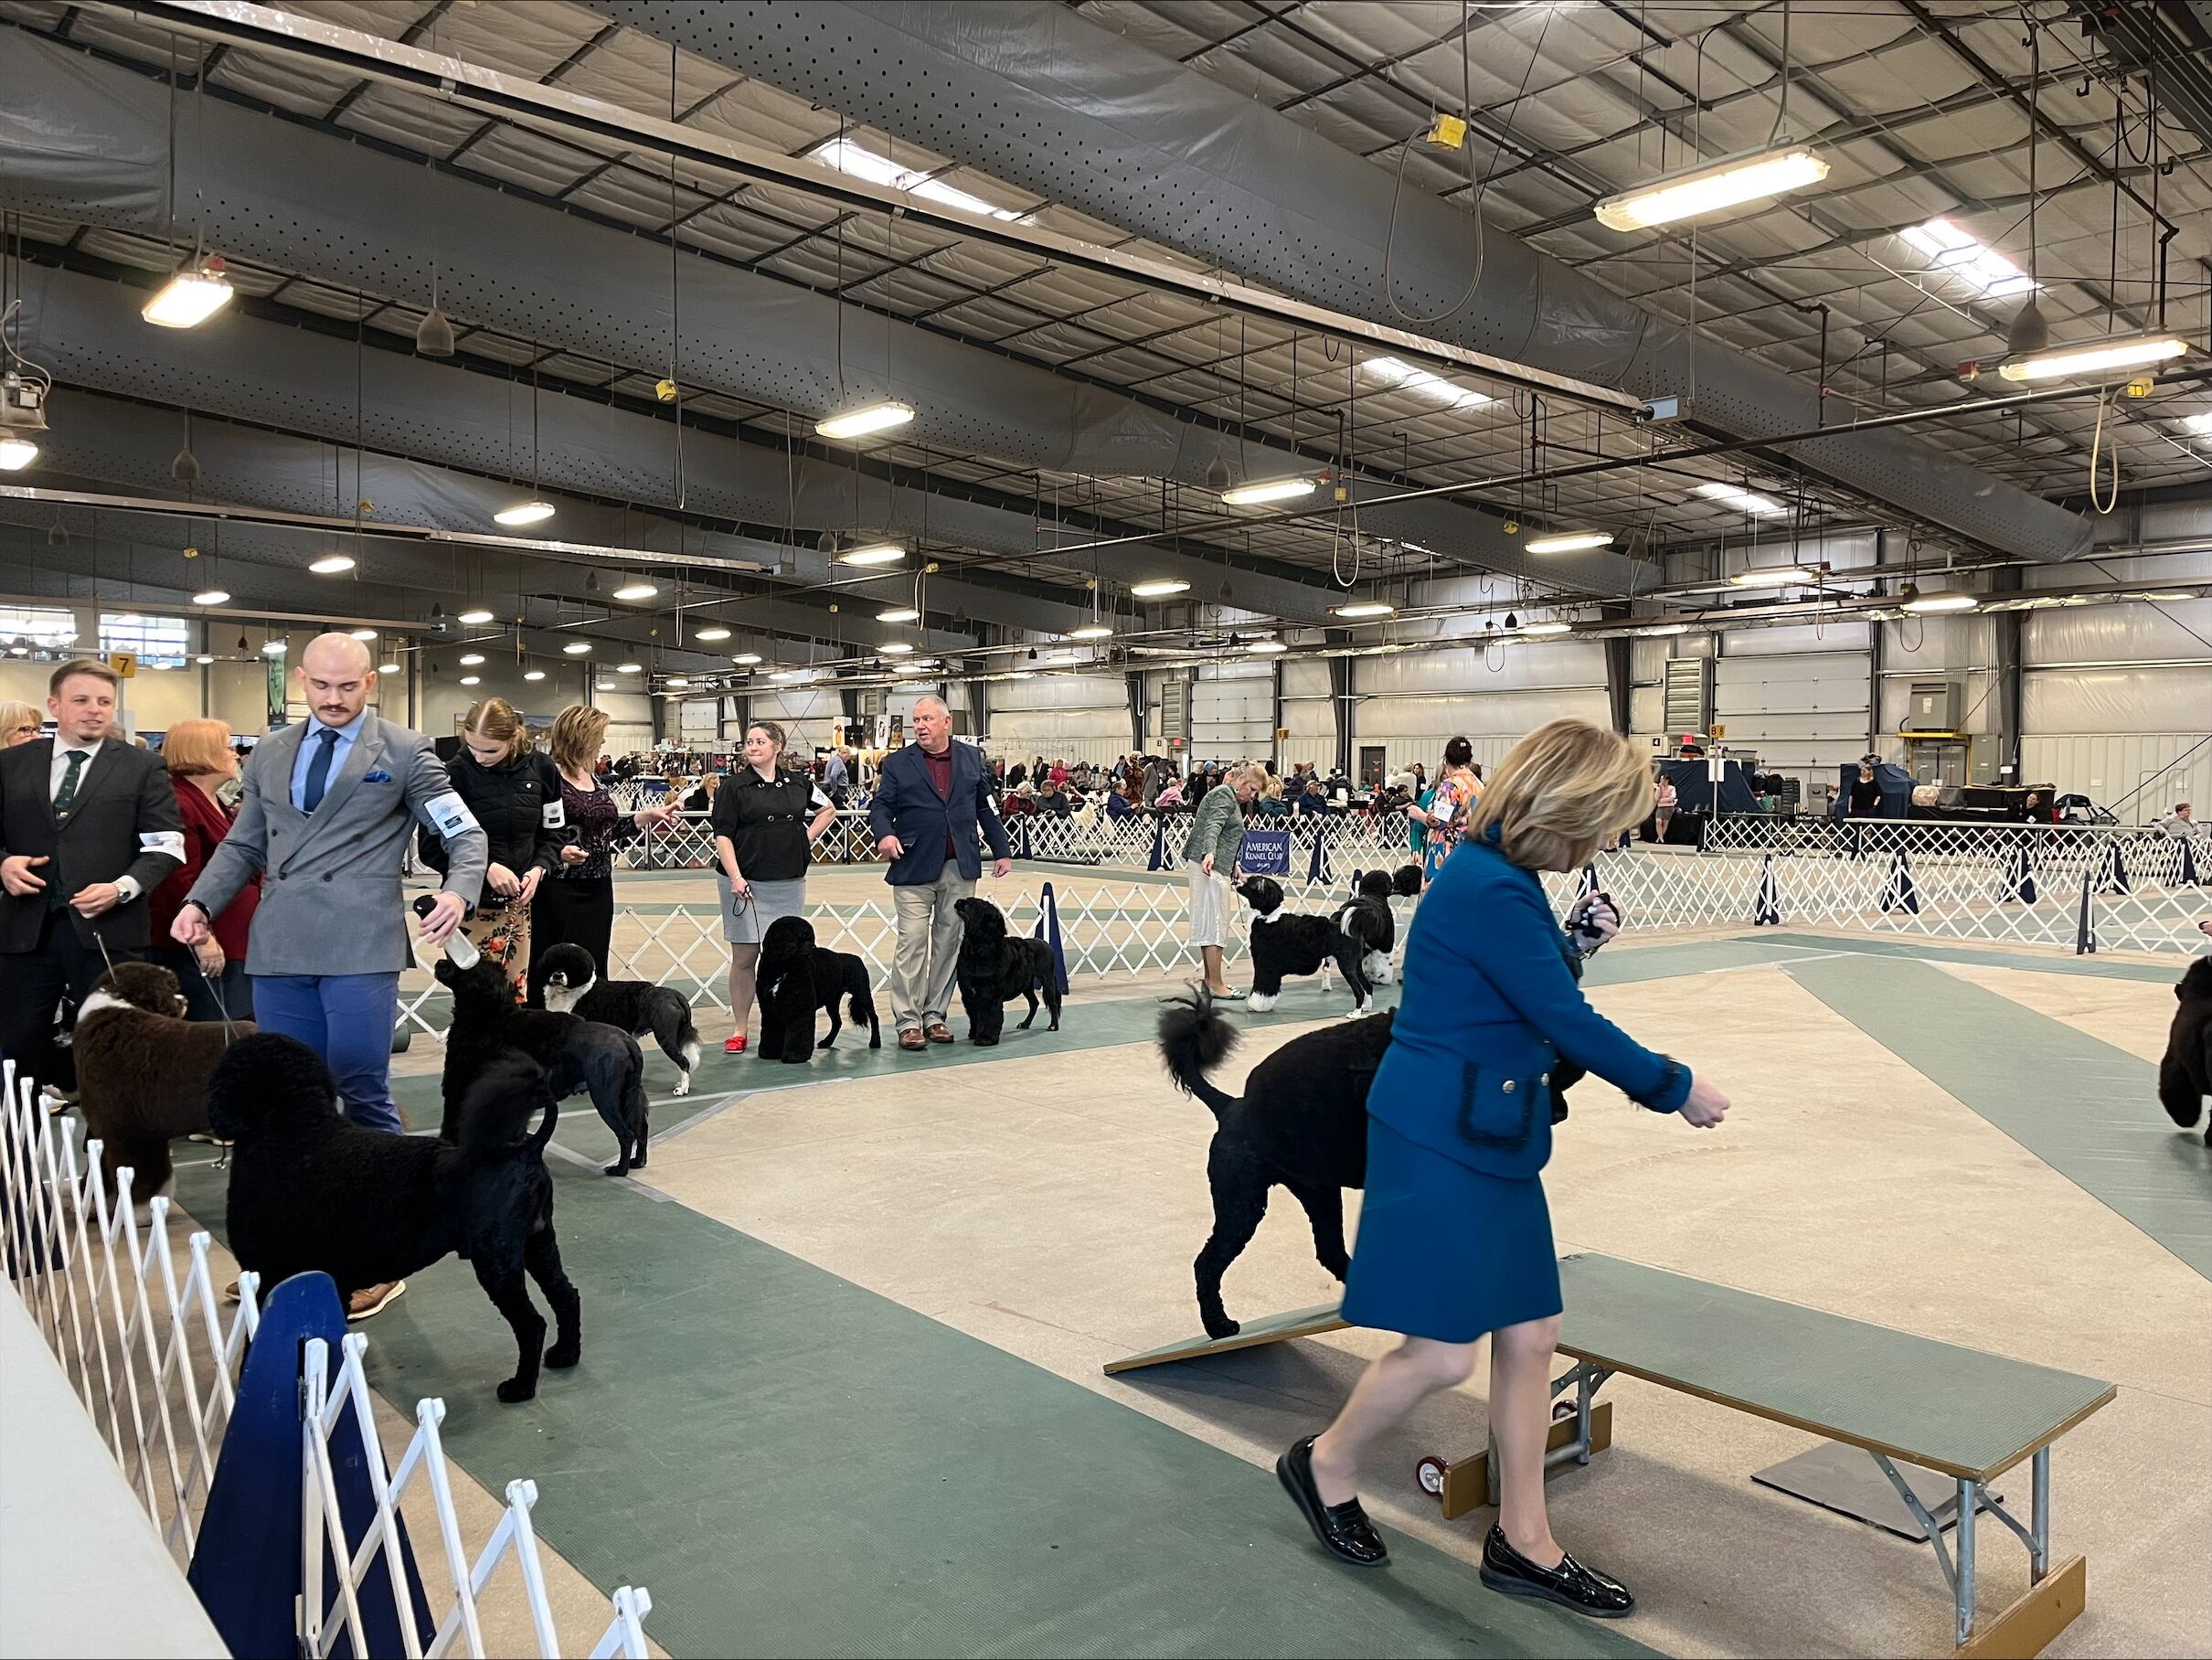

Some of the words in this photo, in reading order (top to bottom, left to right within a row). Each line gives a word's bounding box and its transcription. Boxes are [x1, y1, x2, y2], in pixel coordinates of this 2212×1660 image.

[119, 657, 129, 674] 7
[1711, 726, 1717, 736] 8
[1246, 842, 1282, 851] AMERICAN
[1245, 851, 1266, 859] KENNEL
[1268, 851, 1283, 860] CLUB
